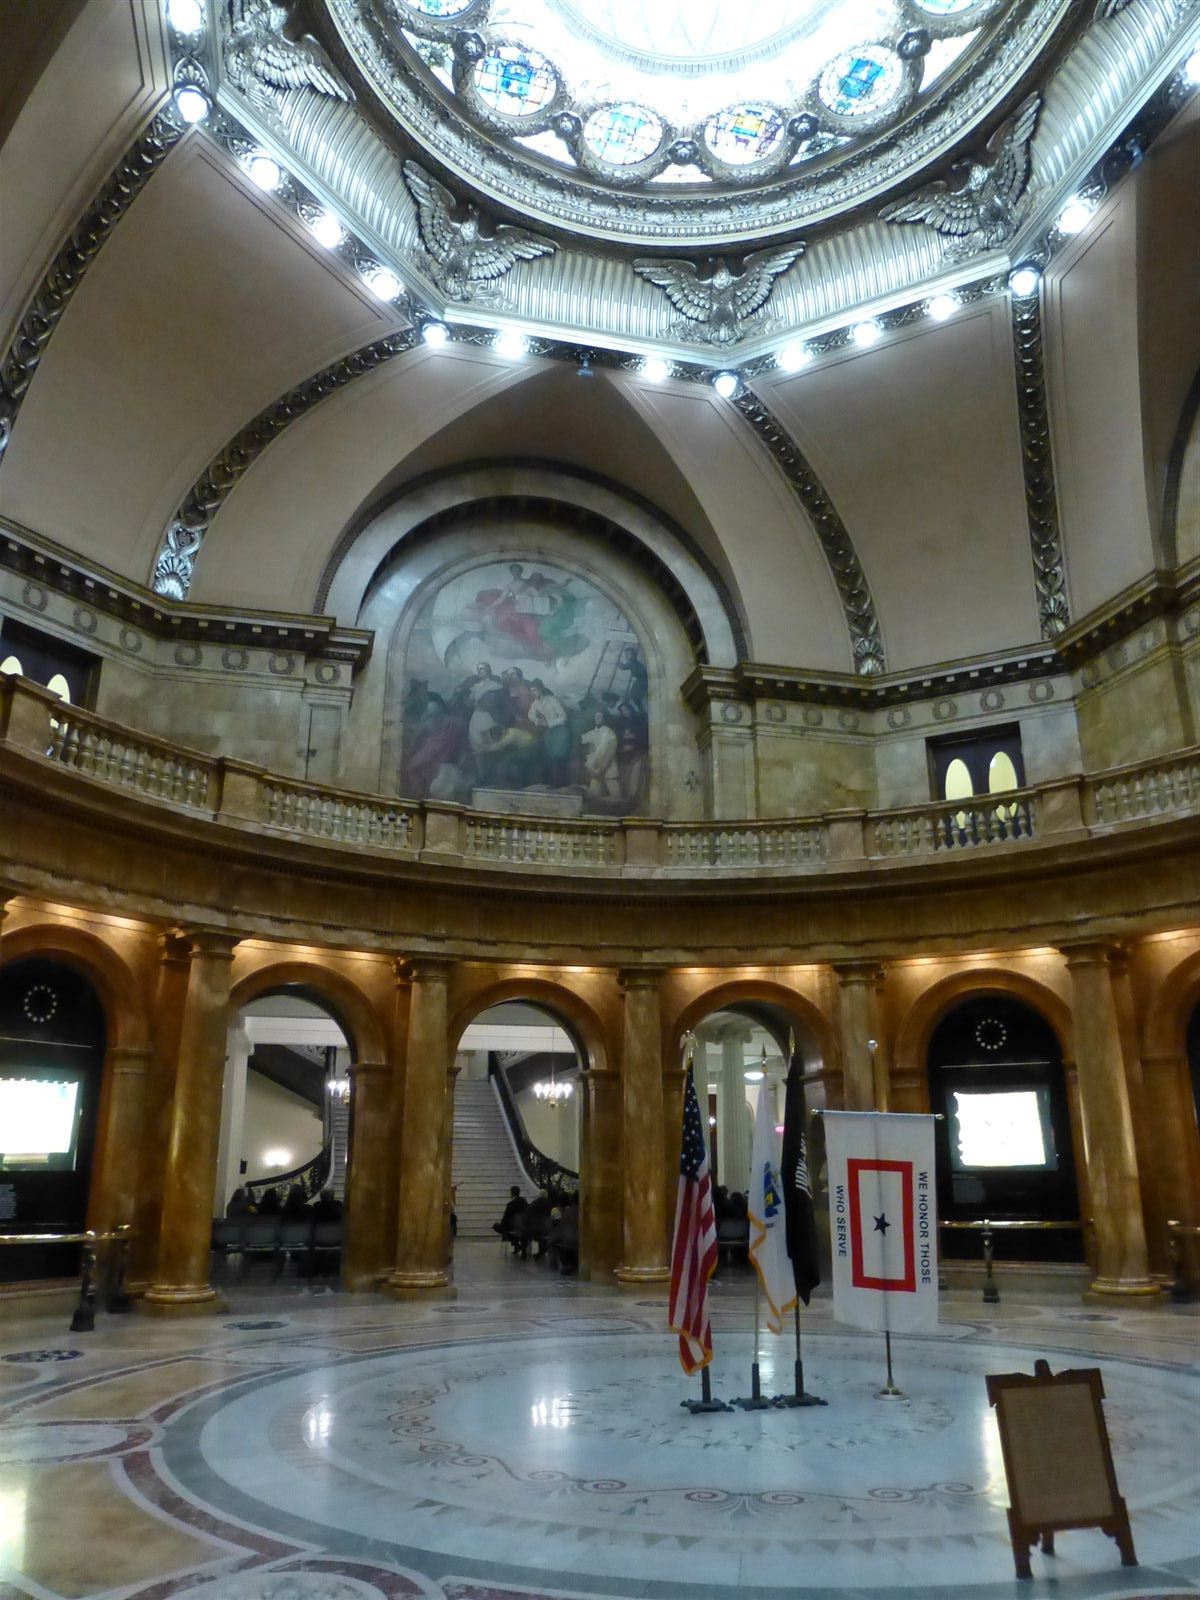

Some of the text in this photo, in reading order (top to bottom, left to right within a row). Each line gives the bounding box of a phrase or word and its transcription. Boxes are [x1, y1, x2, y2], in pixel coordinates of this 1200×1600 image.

[836, 1185, 847, 1257] WHO SERVE
[919, 1172, 931, 1284] WE HONOR THOSE
